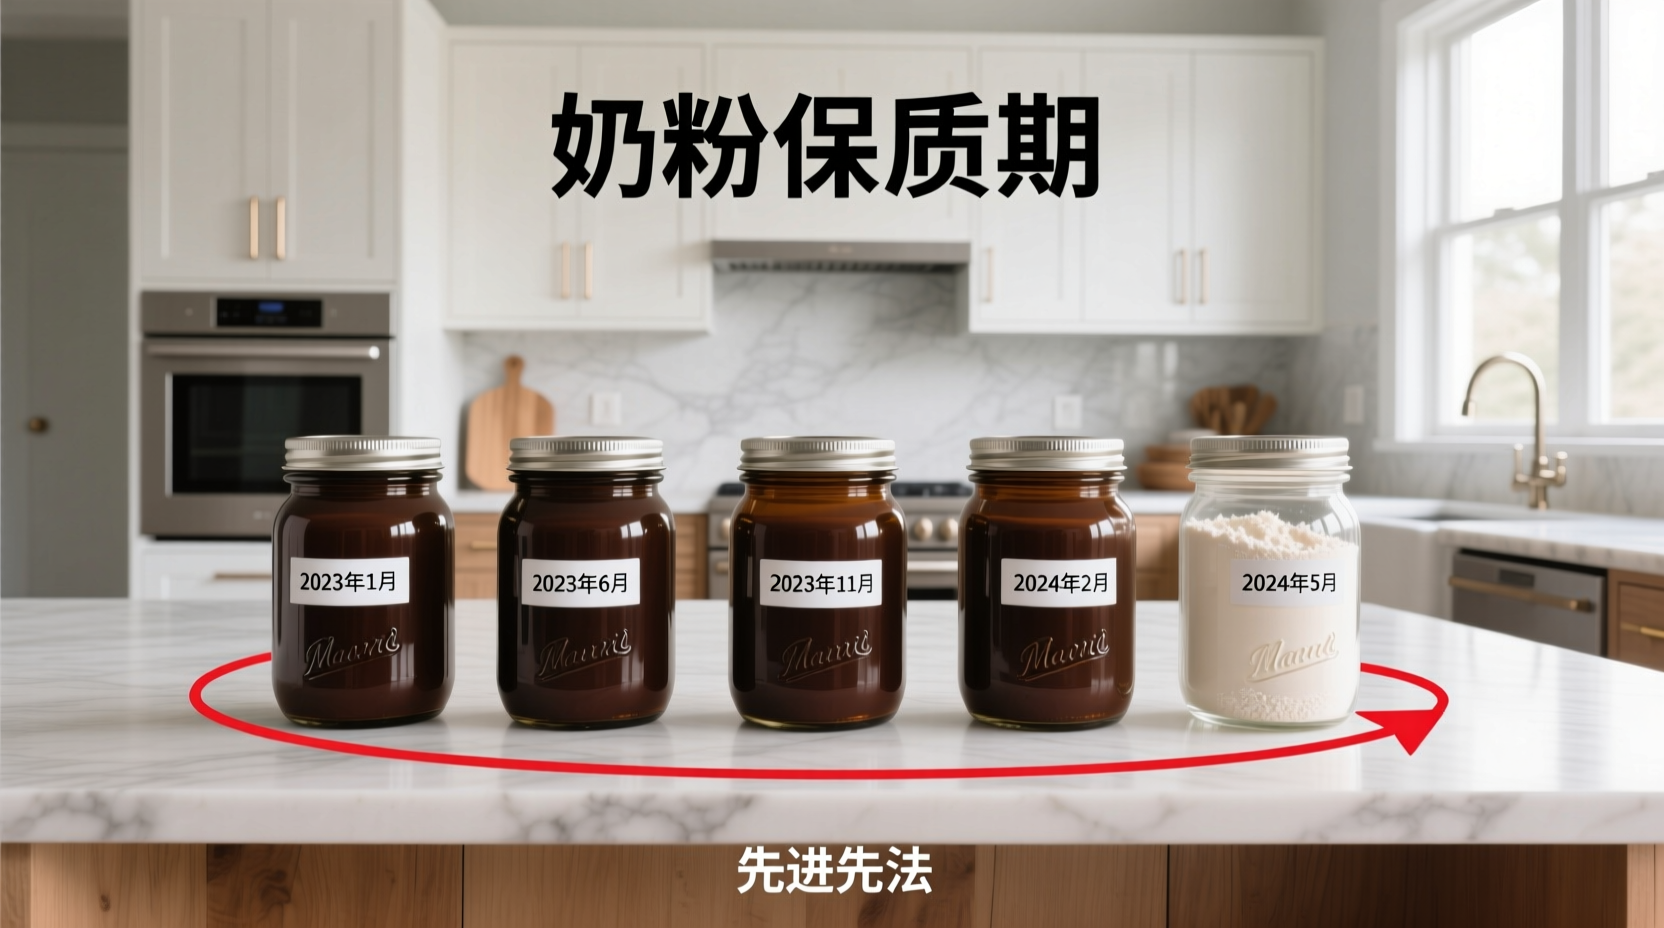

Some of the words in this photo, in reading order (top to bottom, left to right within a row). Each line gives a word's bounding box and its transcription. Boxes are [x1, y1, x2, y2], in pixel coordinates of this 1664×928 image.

[299, 571, 395, 593] 2023年1月
[532, 572, 628, 595] 2023年6月
[769, 573, 874, 596] 2023年11月
[1013, 572, 1109, 594] 2024年2月
[1241, 572, 1337, 594] 2024年5月
